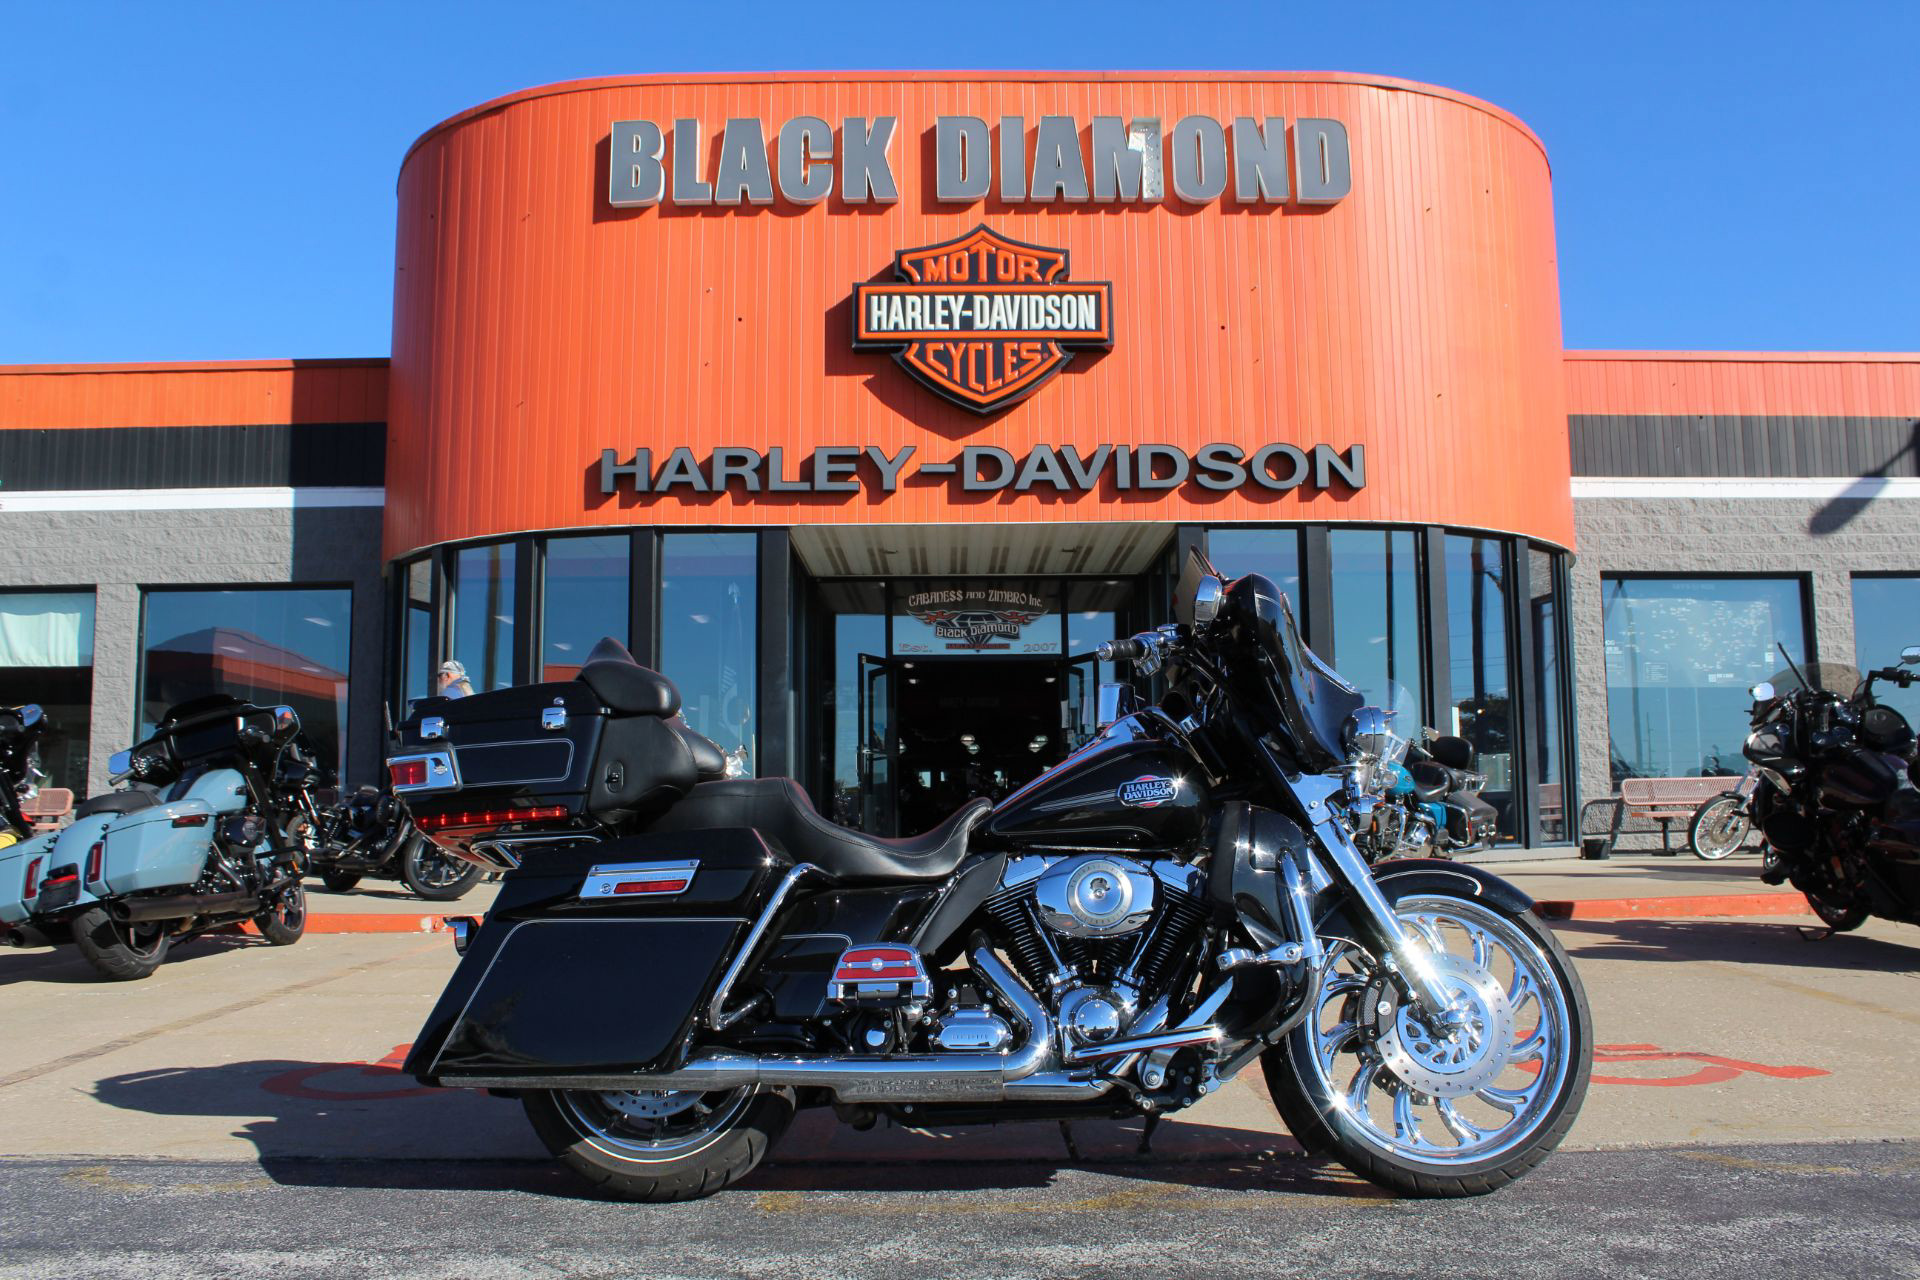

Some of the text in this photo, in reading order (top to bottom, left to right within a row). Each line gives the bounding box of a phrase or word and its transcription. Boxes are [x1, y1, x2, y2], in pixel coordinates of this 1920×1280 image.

[608, 114, 1352, 208] BLACK DIAMOND
[922, 240, 1043, 283] MOTOR
[869, 293, 1097, 332] HARLEY-DAVIDSON
[925, 341, 1043, 394] CYCLES
[600, 442, 1367, 494] HARLEY-DAVIDSON
[988, 589, 1028, 605] ZIMBRO
[1028, 594, 1043, 608] Inc.
[1023, 642, 1058, 653] 2007
[1124, 787, 1173, 800] DAVIDSON
[1126, 782, 1170, 792] HARLEY-
